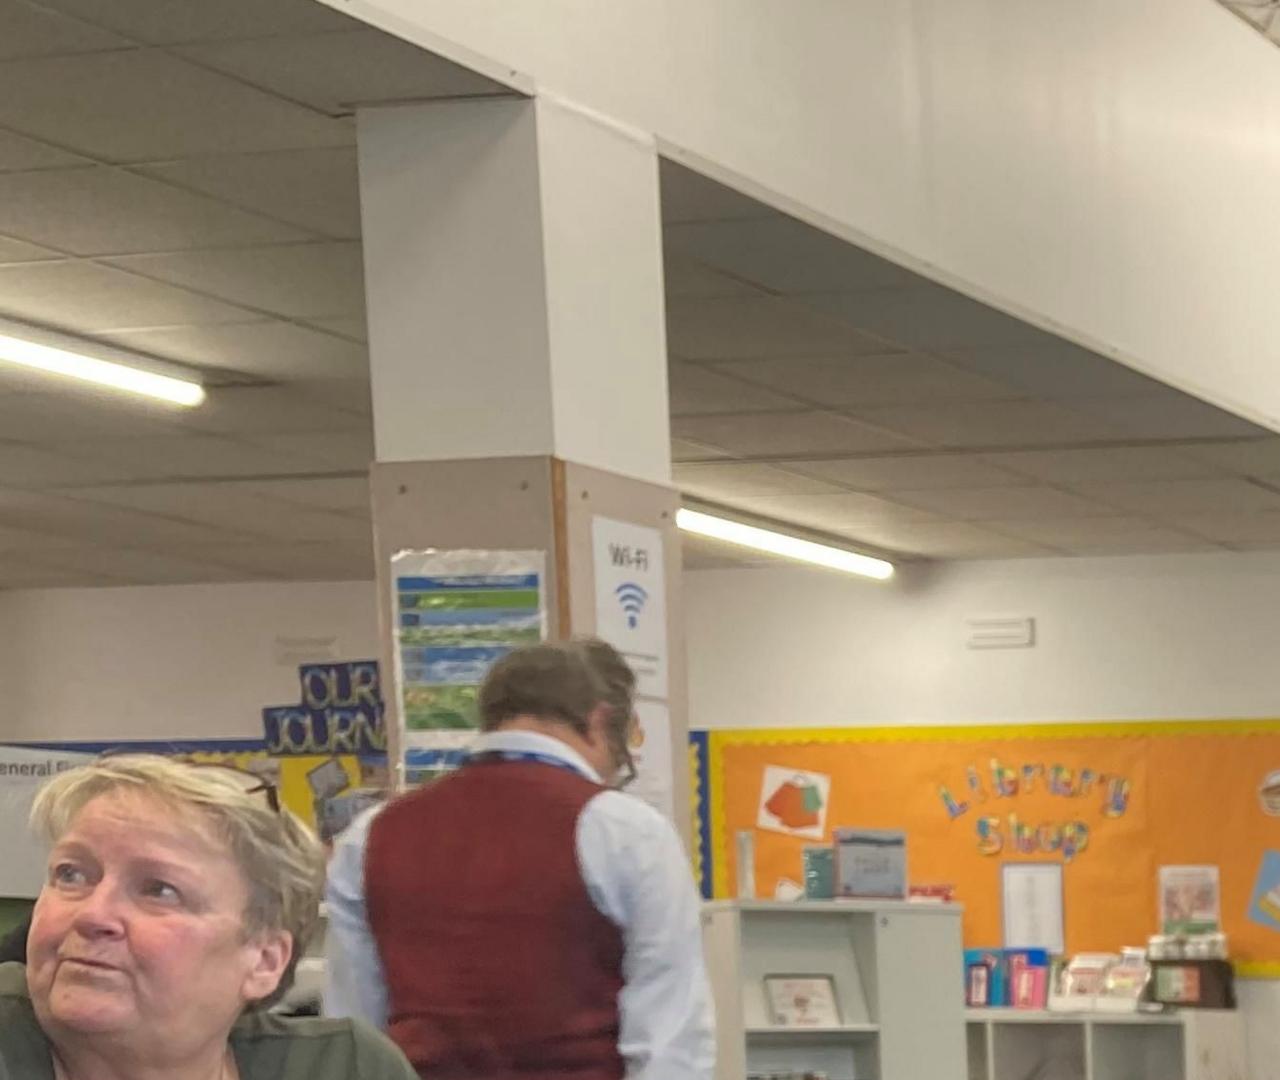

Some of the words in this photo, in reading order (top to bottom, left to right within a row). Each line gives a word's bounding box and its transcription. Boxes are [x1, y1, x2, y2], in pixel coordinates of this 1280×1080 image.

[607, 542, 650, 571] Wi-Fi
[303, 664, 378, 710] OUR
[266, 708, 387, 754] JOURN
[0, 760, 51, 777] eneral
[938, 757, 1140, 820] Library
[976, 812, 1089, 865] Shop
